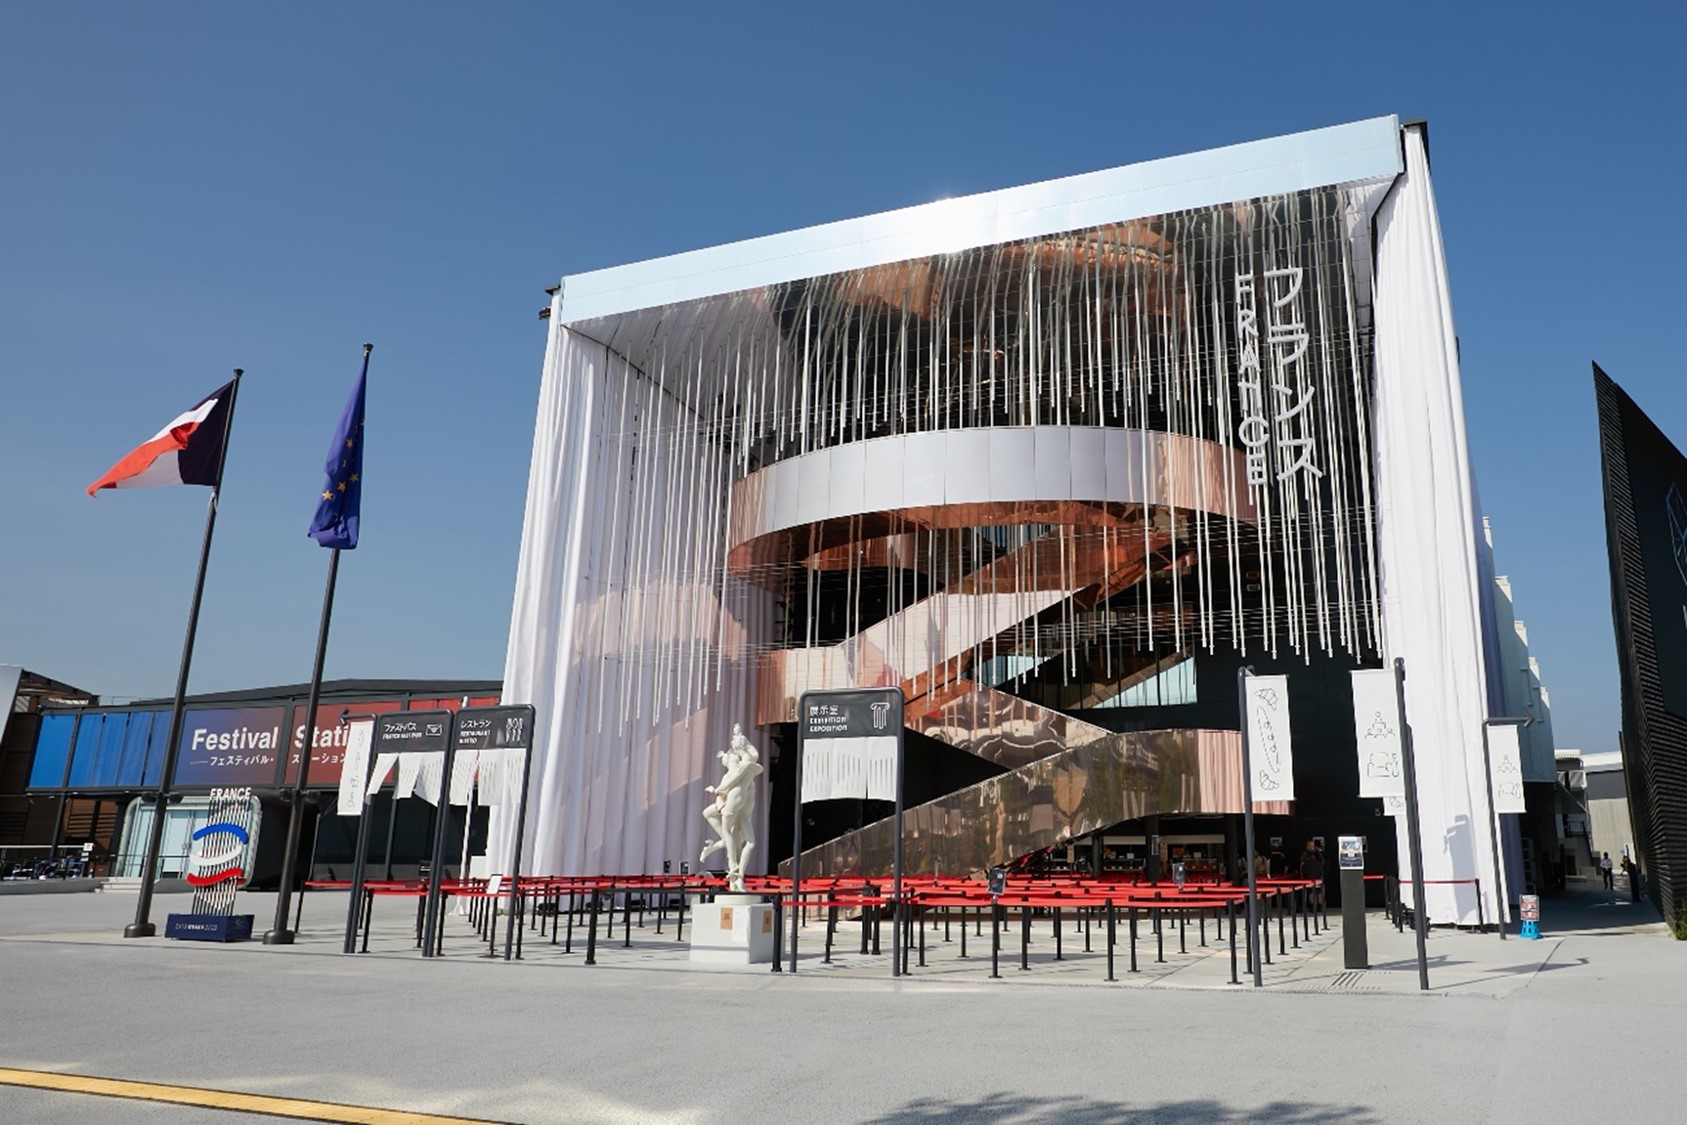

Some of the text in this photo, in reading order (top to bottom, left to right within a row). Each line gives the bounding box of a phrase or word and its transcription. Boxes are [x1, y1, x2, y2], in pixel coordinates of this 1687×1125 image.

[1235, 273, 1271, 486] FRANCE
[1264, 267, 1324, 481] フランス
[460, 719, 492, 729] レストラン
[191, 725, 350, 751] Festival Stati
[210, 787, 252, 801] FRANCE
